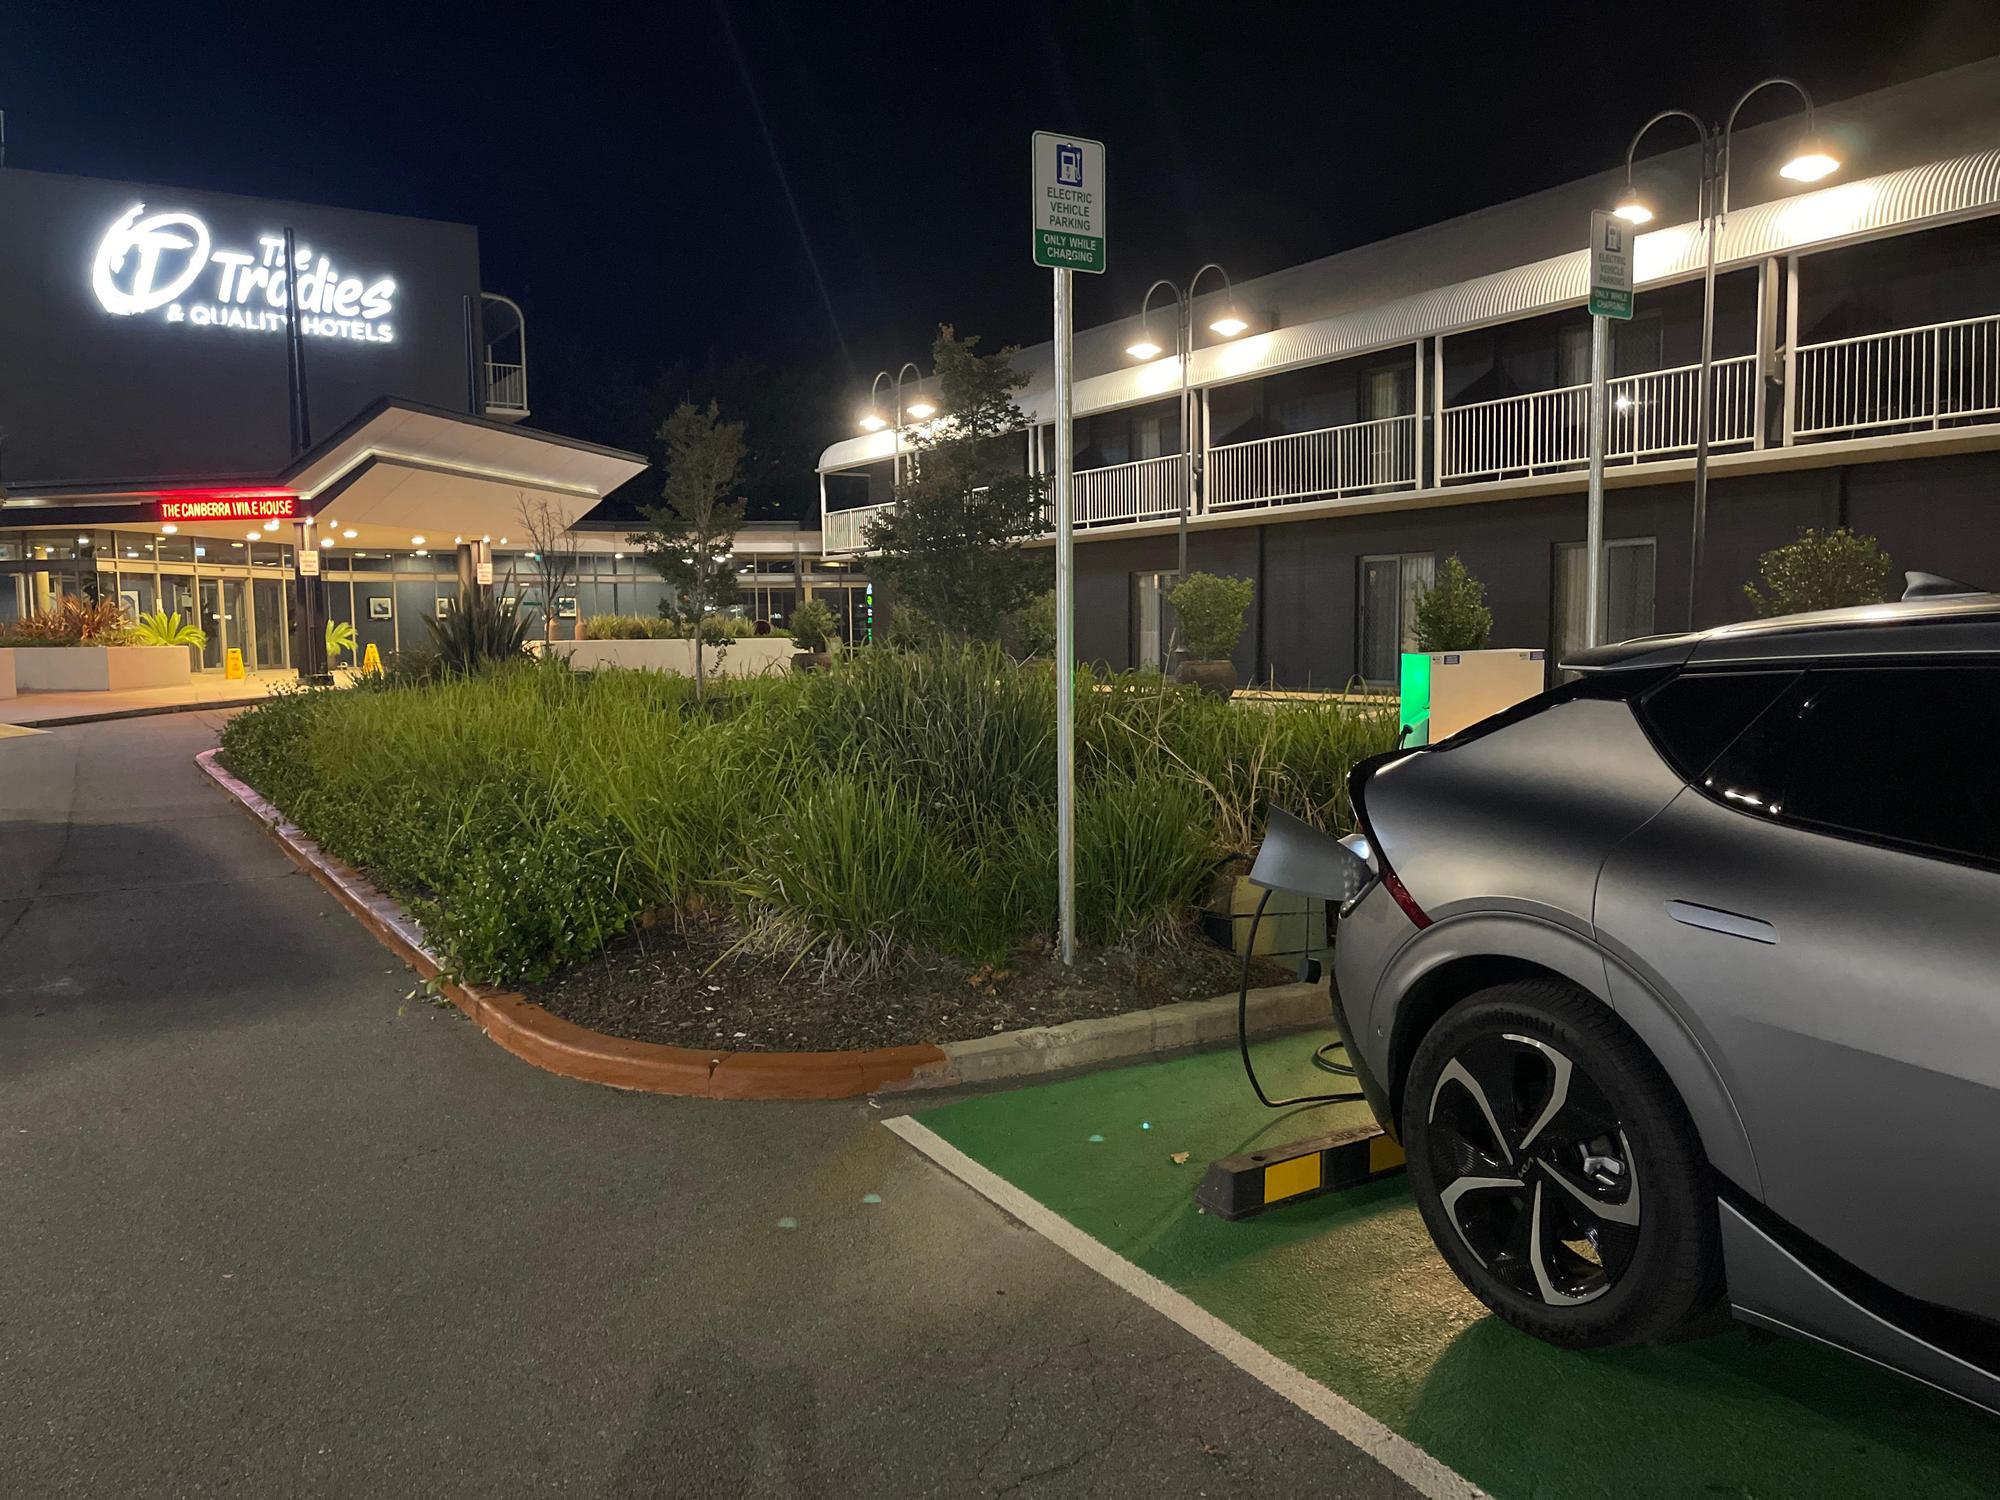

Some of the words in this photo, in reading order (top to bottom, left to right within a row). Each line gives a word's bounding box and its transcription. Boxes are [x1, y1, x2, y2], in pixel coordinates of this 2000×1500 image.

[1047, 187, 1092, 203] ELECTRIC
[1050, 201, 1089, 217] VEHICLE
[1049, 215, 1090, 231] PARKING
[1043, 233, 1067, 247] ONLY
[1069, 236, 1097, 251] WHILE
[1047, 247, 1093, 263] CHARGING
[210, 250, 396, 319] Tradies
[166, 303, 185, 323] &
[302, 317, 393, 344] HOTELS
[162, 503, 181, 518] THE
[181, 502, 231, 518] CANBERRA
[259, 500, 293, 515] HOUSE
